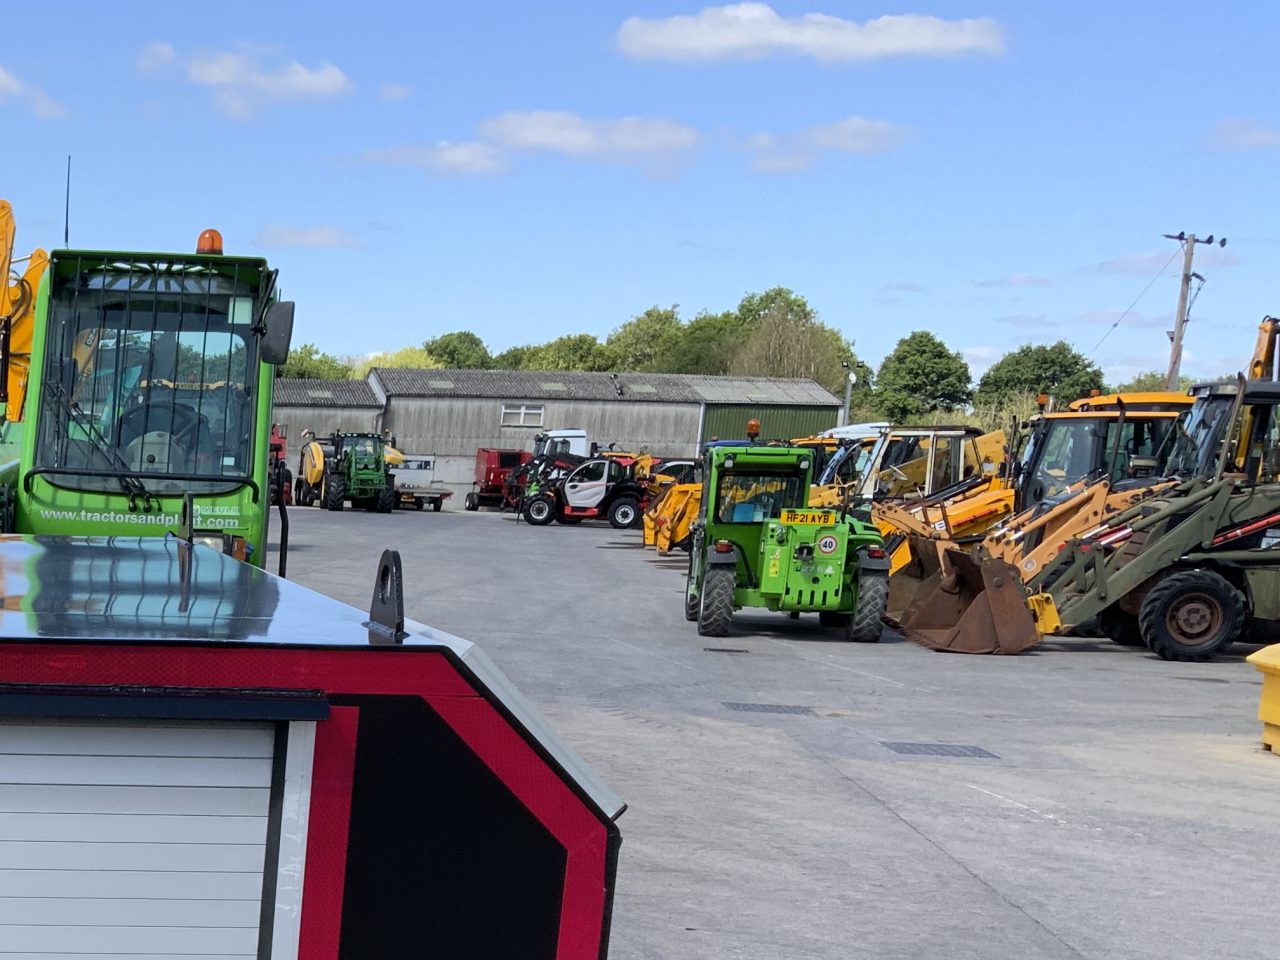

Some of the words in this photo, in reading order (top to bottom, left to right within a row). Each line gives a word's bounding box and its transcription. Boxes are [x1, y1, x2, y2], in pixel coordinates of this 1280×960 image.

[40, 508, 239, 529] www.tractorsandplt.com
[786, 513, 808, 523] HF21
[810, 514, 830, 524] AYB
[822, 540, 833, 550] 40
